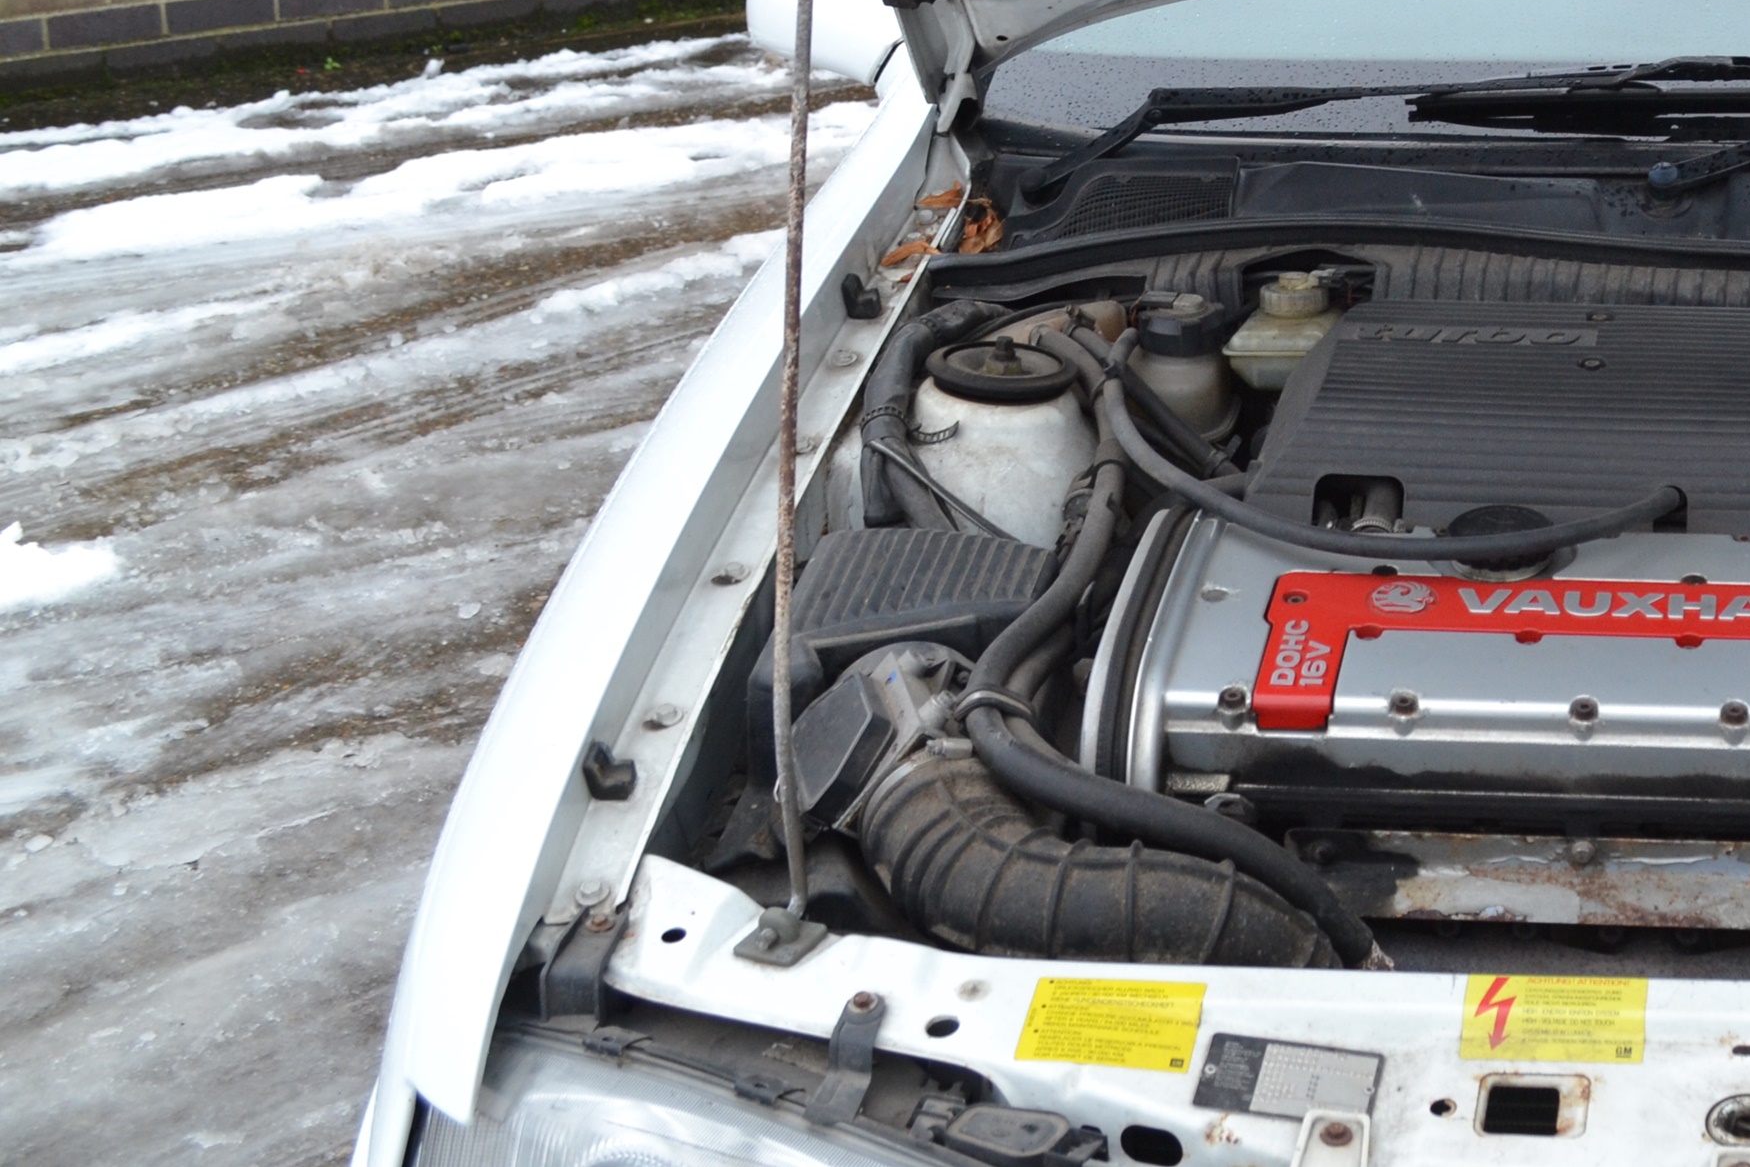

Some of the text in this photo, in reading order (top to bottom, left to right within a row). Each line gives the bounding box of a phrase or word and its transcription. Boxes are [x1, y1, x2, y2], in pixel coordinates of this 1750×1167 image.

[1356, 323, 1582, 346] turbo
[1269, 619, 1310, 687] DOHC
[1299, 640, 1332, 688] 16V
[1615, 1046, 1632, 1054] GM
